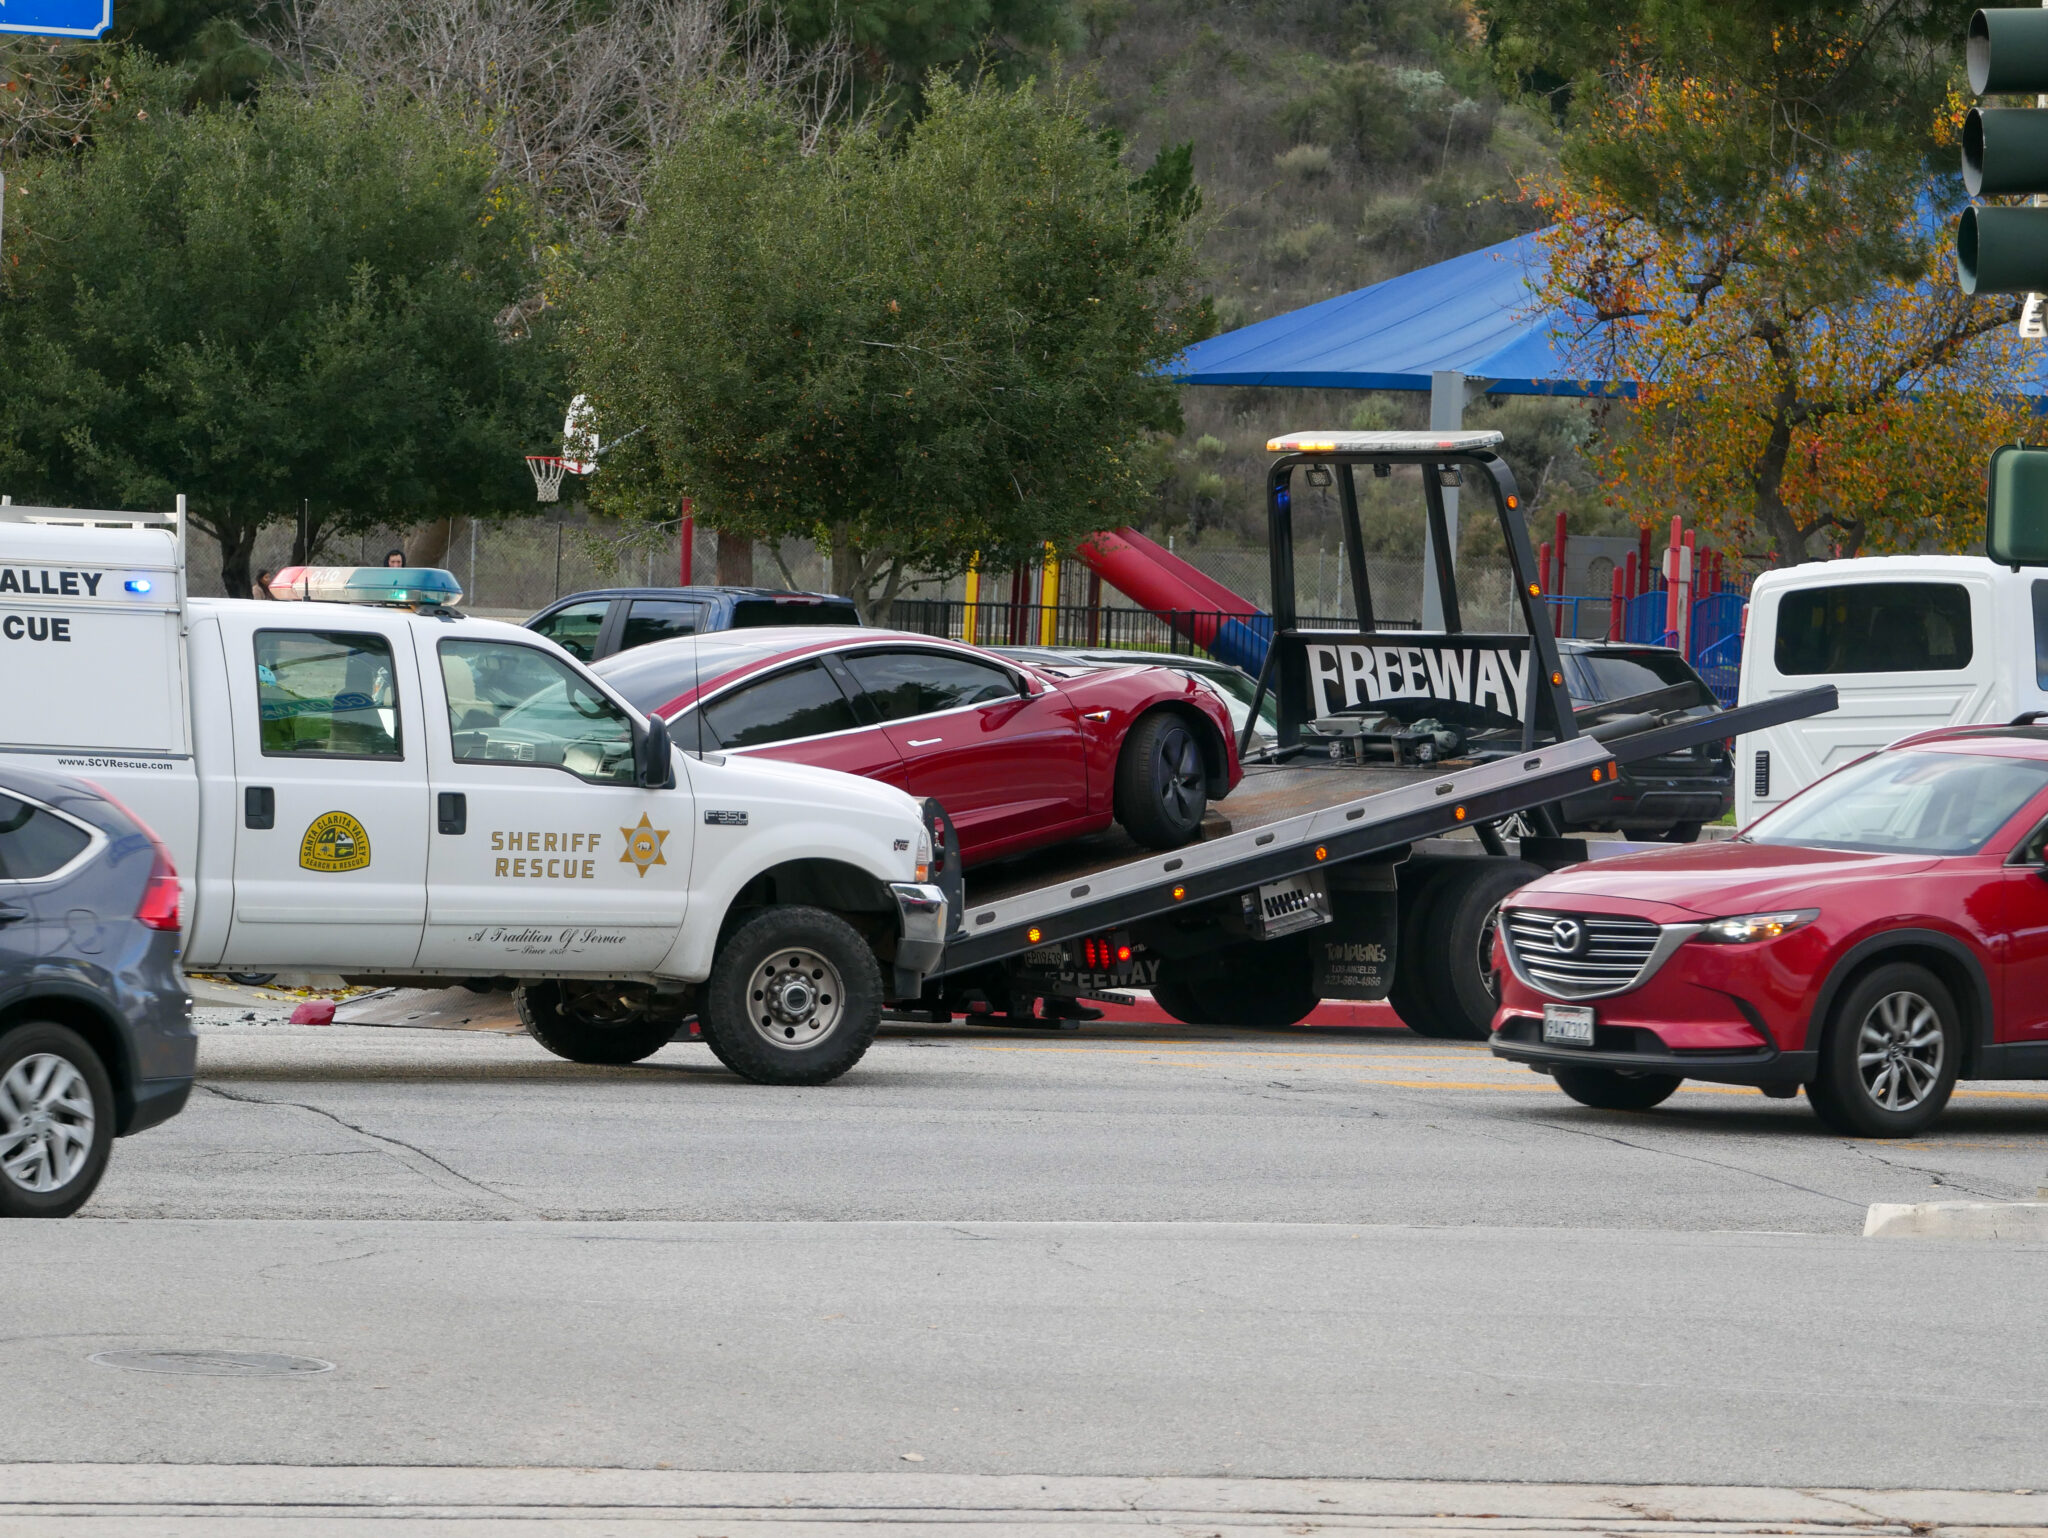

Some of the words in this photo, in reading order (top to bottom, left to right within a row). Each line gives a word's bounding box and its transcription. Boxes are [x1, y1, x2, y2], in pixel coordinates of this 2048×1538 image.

[0, 569, 102, 597] ALLEY
[2, 615, 71, 642] CUE
[1305, 644, 1530, 724] FREEWAY
[57, 757, 173, 770] www.SCVRescue.com
[304, 829, 318, 857] SANTA
[317, 815, 351, 830] CLARITA
[352, 825, 366, 856] VALLEY
[491, 831, 601, 852] SHERIFF
[305, 858, 330, 870] SEARCH
[339, 857, 364, 870] RESCUE
[495, 858, 595, 879] RESCUE
[468, 927, 487, 942] A
[490, 927, 553, 943] Tradition
[559, 927, 579, 949] Of
[579, 927, 626, 944] Service
